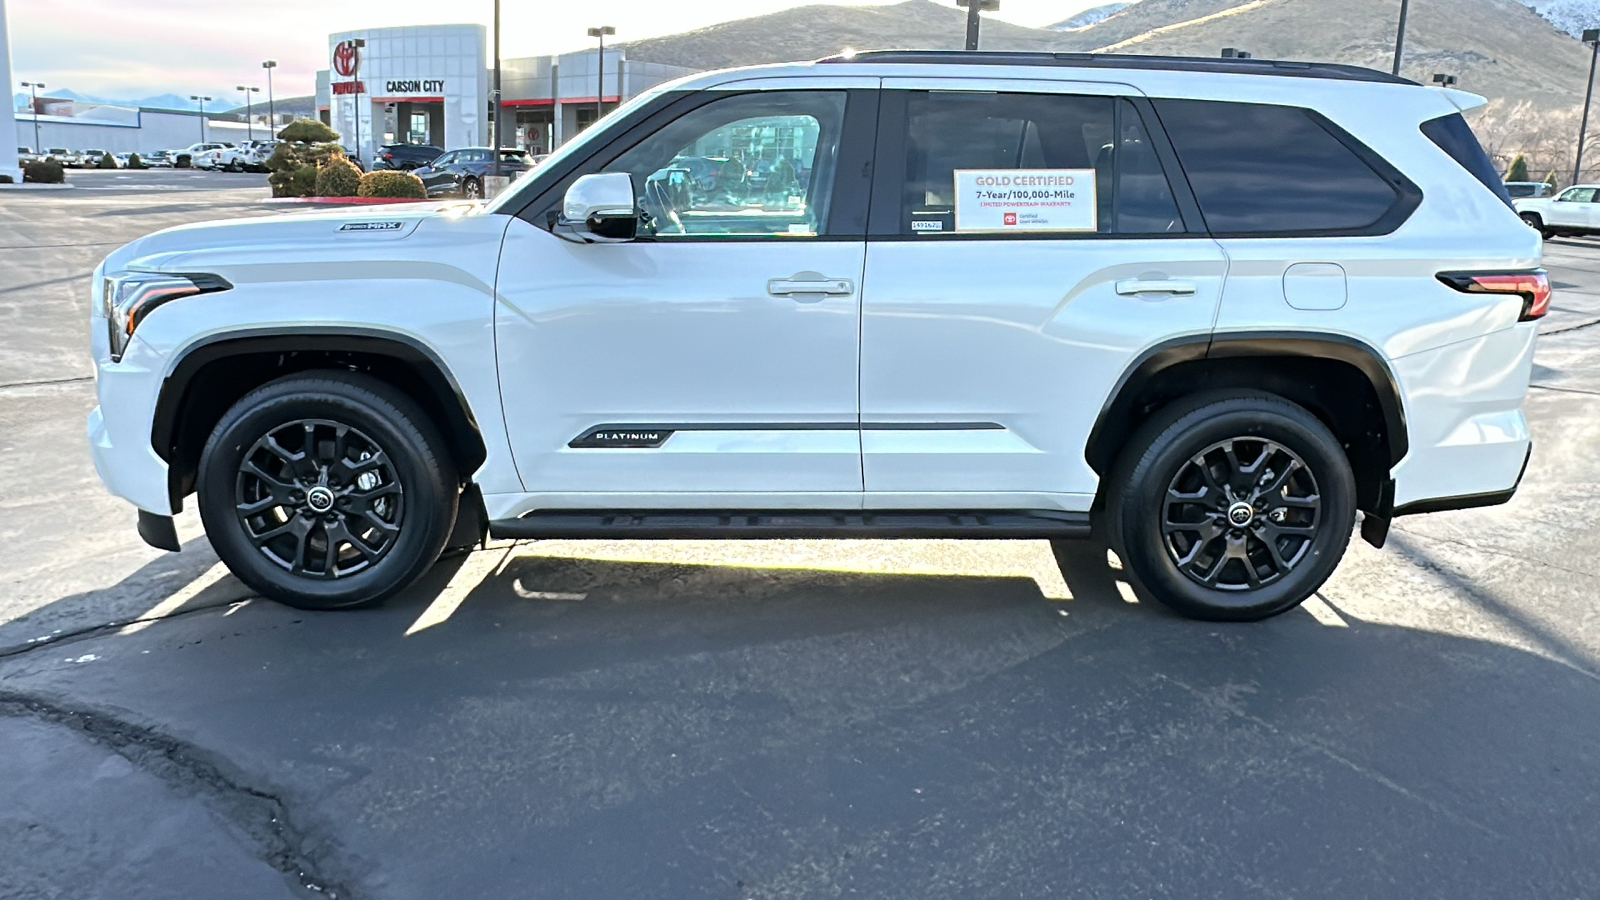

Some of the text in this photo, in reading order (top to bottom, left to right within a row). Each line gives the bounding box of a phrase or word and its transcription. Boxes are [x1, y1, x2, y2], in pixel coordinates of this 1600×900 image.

[386, 80, 445, 93] CARSON CITY
[975, 176, 1075, 186] GOLD CERTIFIED
[976, 190, 1075, 200] 7-Year/100,000-Mile
